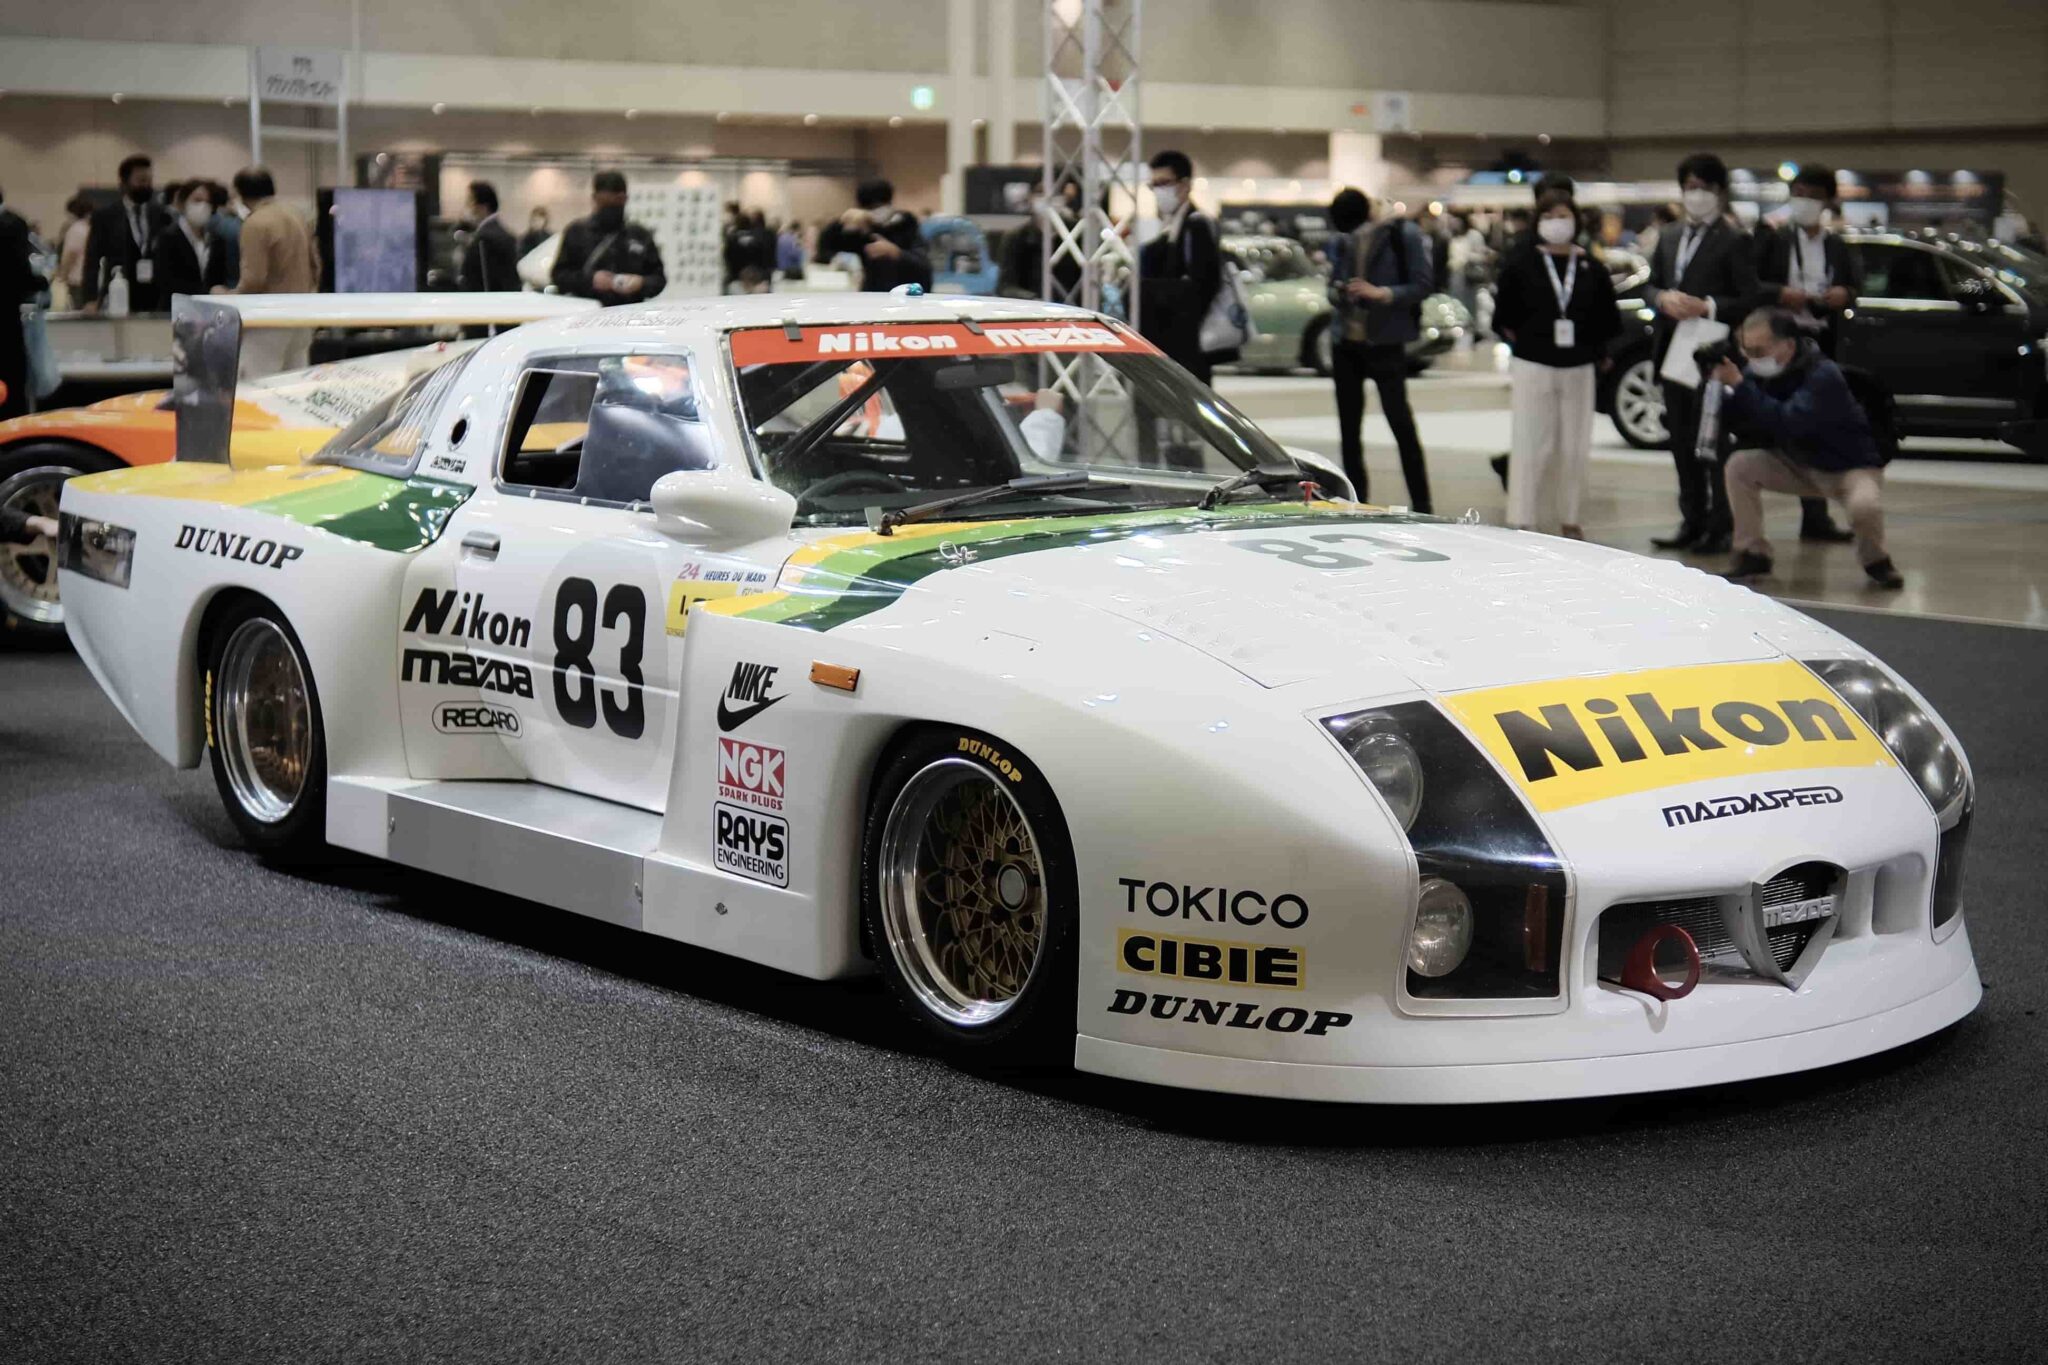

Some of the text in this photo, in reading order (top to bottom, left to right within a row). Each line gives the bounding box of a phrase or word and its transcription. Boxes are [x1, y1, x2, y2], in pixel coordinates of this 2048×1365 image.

[818, 333, 957, 354] Nikon
[175, 525, 304, 569] DUNLOP
[1227, 533, 1452, 570] 83
[678, 562, 701, 580] 24
[703, 570, 731, 582] HEURES
[731, 571, 744, 582] DU
[403, 588, 531, 648] Nikon
[553, 576, 647, 739] 83
[727, 661, 779, 702] NIKE
[442, 707, 519, 732] RECARO
[1494, 692, 1857, 782] Nikon
[719, 740, 784, 795] NGK
[958, 737, 1023, 783] DUNLOP
[719, 786, 784, 811] SPARK PLUGS
[1662, 786, 1843, 828] MAZDASPEED
[717, 810, 783, 861] RAYS
[717, 849, 784, 880] ENGINEERING
[1118, 877, 1310, 929] TOKICO
[1107, 988, 1353, 1036] DUNLOP
